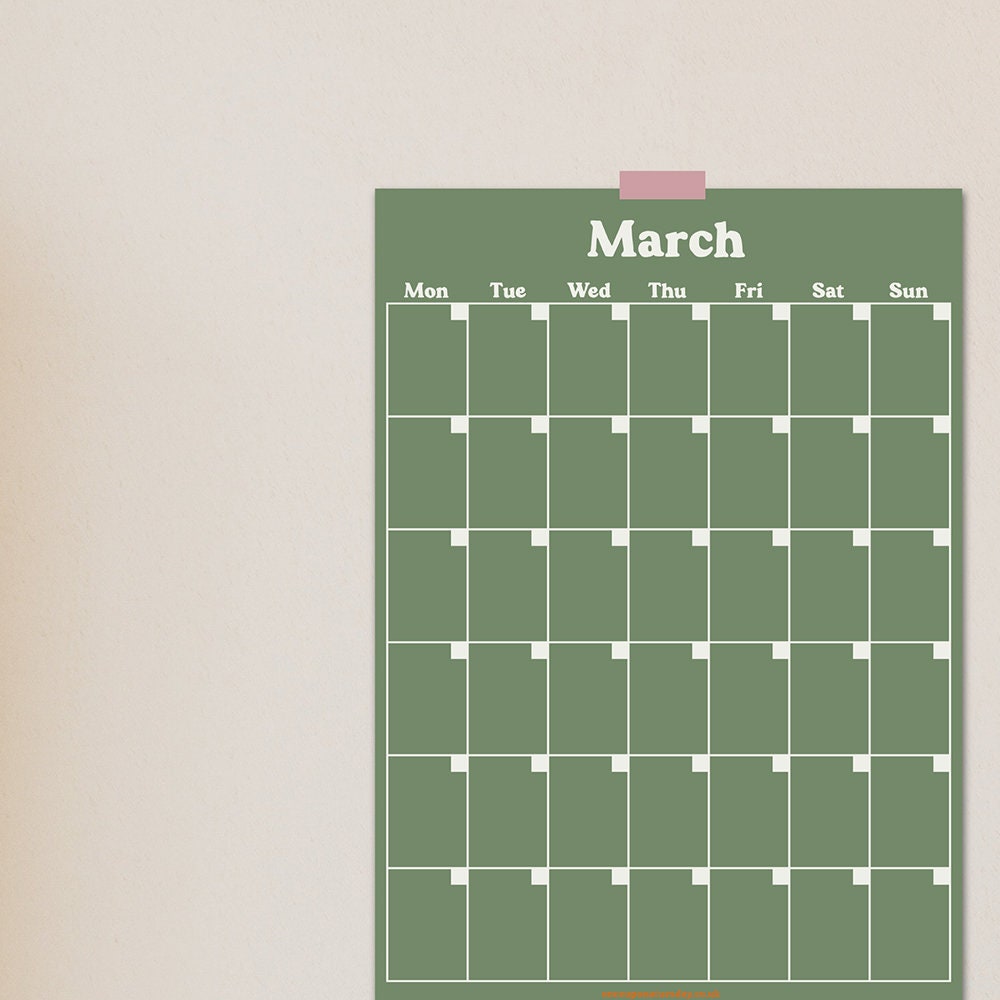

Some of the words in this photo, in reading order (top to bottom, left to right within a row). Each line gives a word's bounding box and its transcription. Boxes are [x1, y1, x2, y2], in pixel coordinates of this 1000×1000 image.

[586, 219, 746, 259] March
[403, 282, 449, 299] Mon
[489, 281, 527, 299] Tue
[566, 281, 612, 299] Wed
[647, 281, 687, 299] Thu
[734, 282, 764, 299] Fri
[811, 281, 845, 299] Sat
[889, 282, 929, 299] Sun
